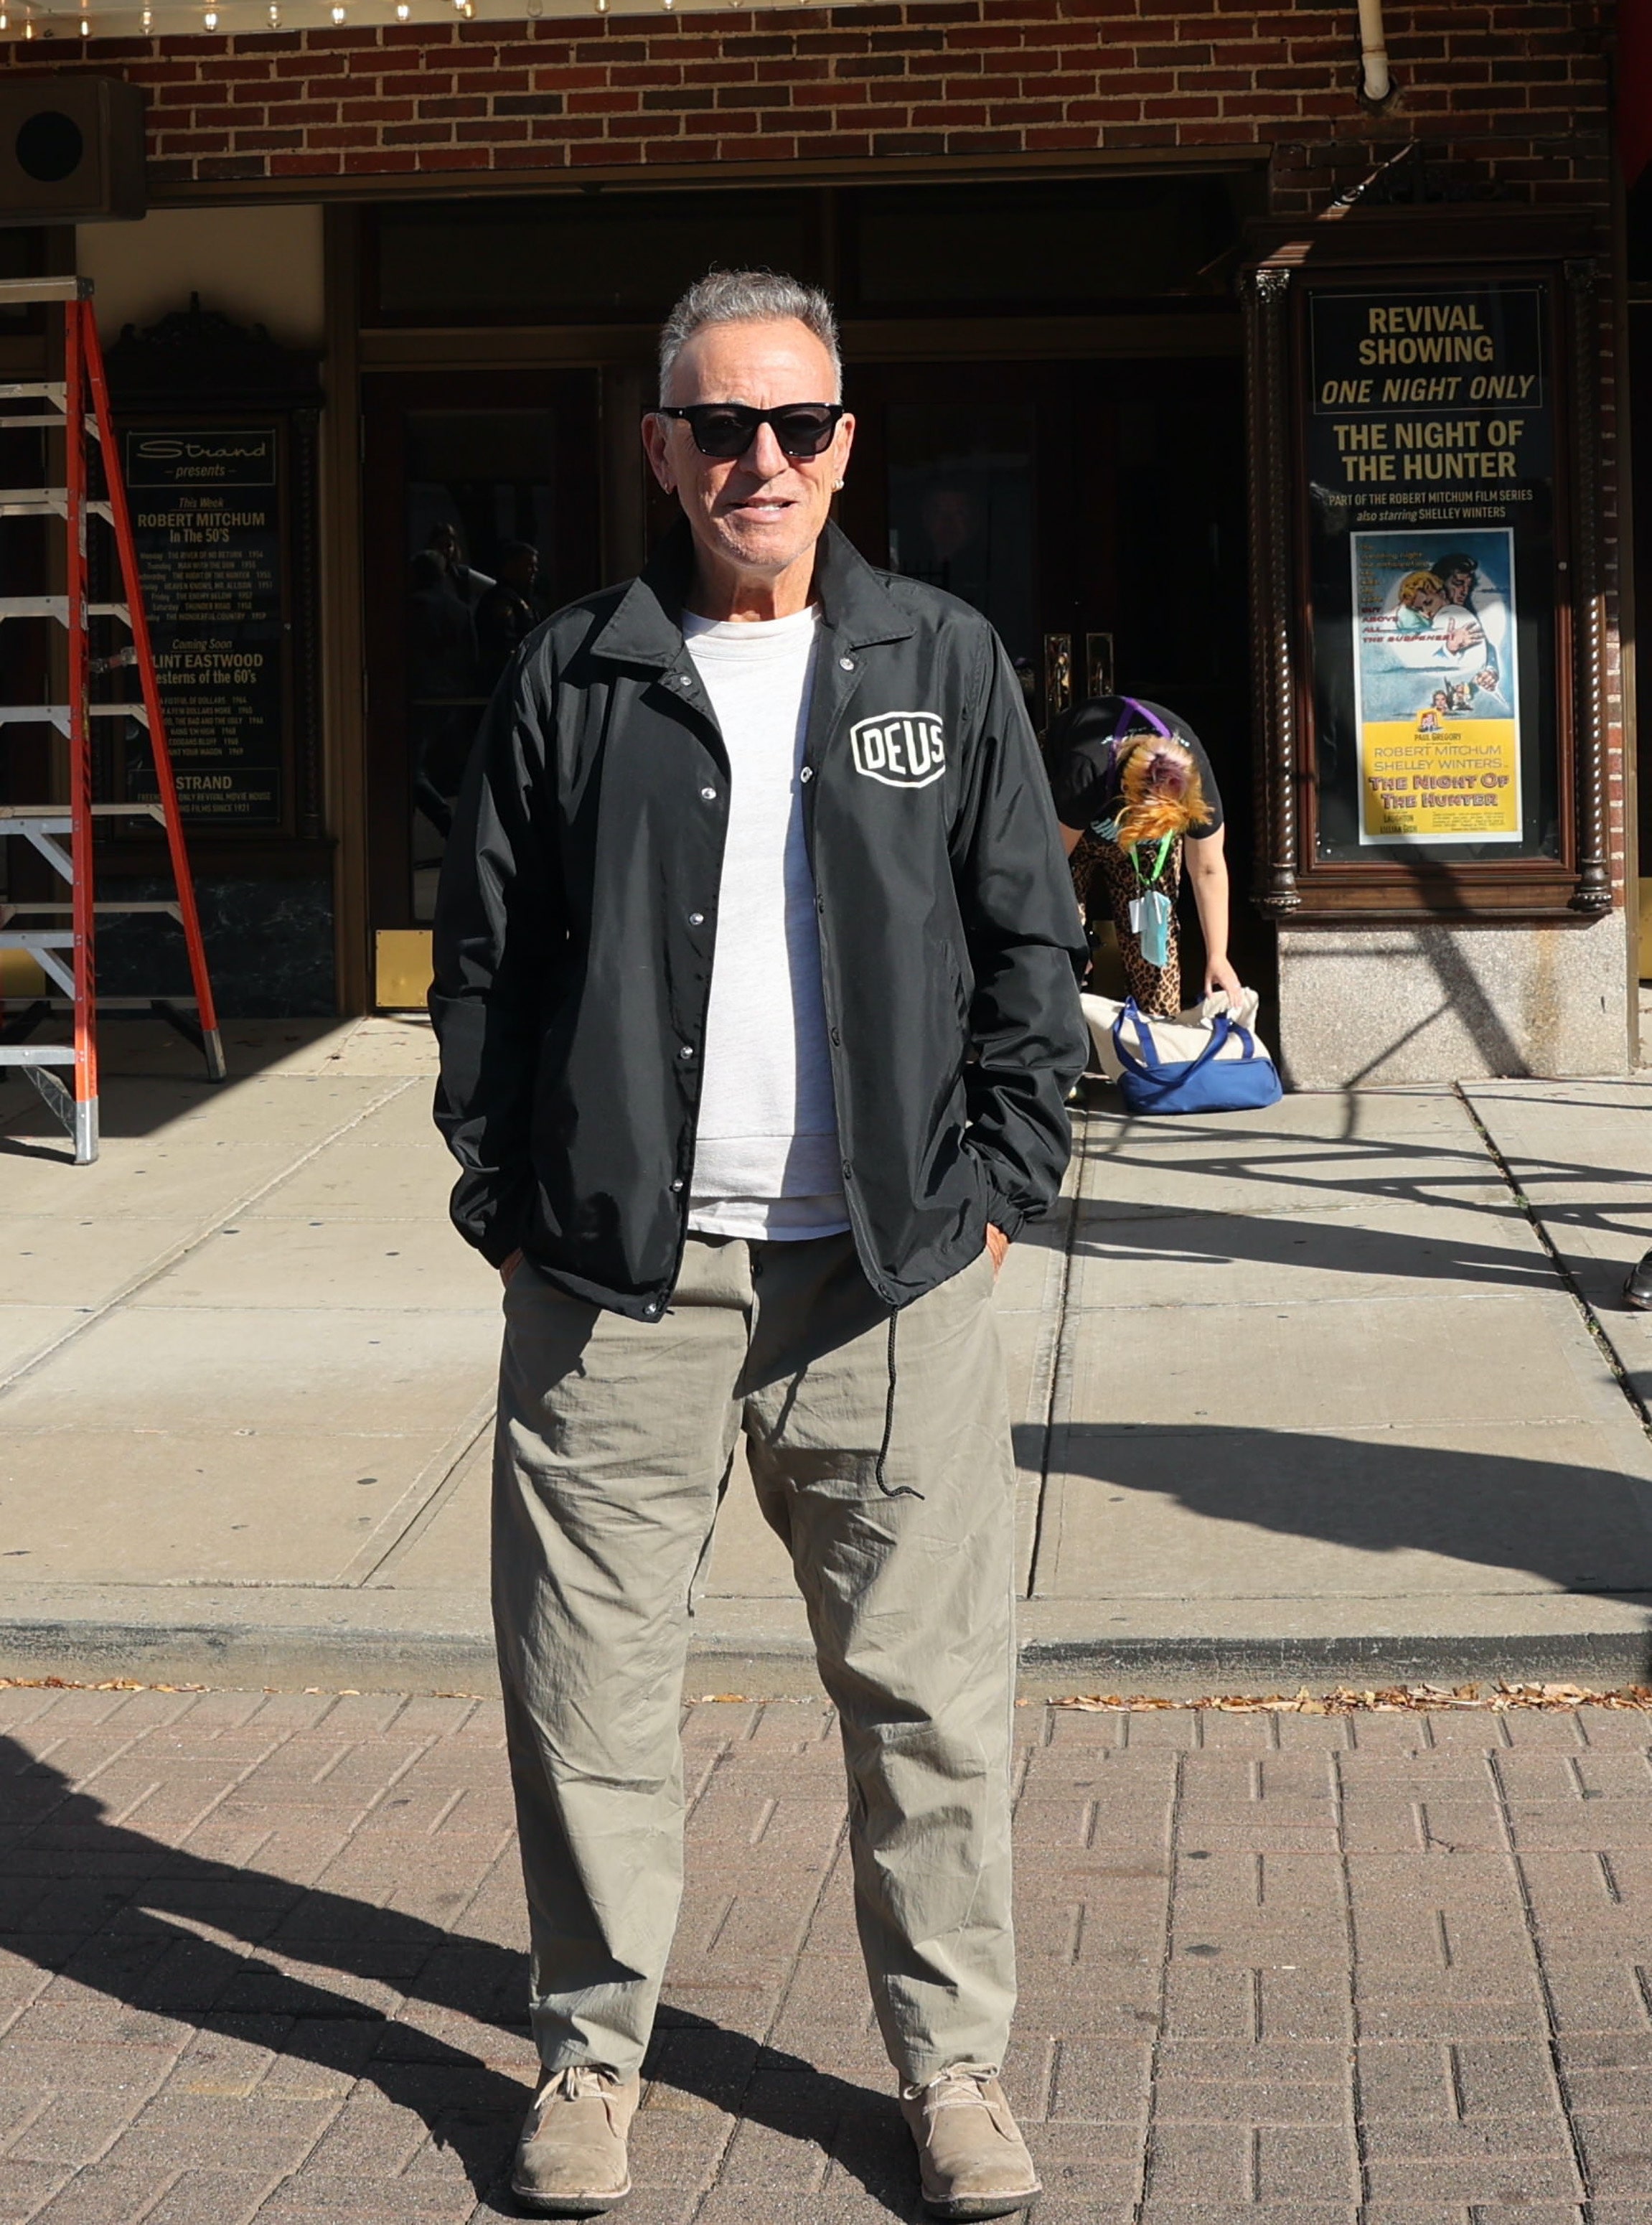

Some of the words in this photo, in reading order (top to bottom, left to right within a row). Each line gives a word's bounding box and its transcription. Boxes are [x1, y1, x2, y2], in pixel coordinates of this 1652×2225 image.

[1369, 305, 1484, 334] REVIVAL
[1359, 336, 1493, 365] SHOWING
[1321, 380, 1374, 404] ONE
[1382, 377, 1461, 403] NIGHT
[1470, 375, 1535, 399] ONLY
[1333, 424, 1388, 451] THE
[1395, 421, 1480, 449] NIGHT
[1488, 420, 1524, 446] OF
[137, 439, 266, 459] Strand
[1341, 455, 1396, 482] THE
[1404, 452, 1516, 480] HUNTER
[179, 497, 197, 508] This
[200, 497, 225, 507] Week
[1328, 495, 1353, 505] PART
[1355, 495, 1367, 505] OF
[1369, 494, 1387, 505] THE
[1389, 492, 1426, 504] ROBERT
[1428, 492, 1473, 503] MITCHUM
[1475, 491, 1497, 502] FILM
[1499, 490, 1533, 501] SERIES
[138, 514, 194, 528] ROBERT
[197, 512, 265, 526] MITCHUM
[1356, 511, 1377, 521] also
[1379, 510, 1417, 523] starring
[1419, 508, 1460, 520] SHELLEY
[1463, 507, 1506, 519] WINTERS
[170, 529, 181, 543] In
[184, 529, 202, 543] The
[205, 528, 230, 543] 50'S
[172, 639, 207, 652] Coming
[209, 638, 233, 650] Soon
[154, 655, 182, 668] LINT
[184, 653, 264, 668] EASTWOOD
[156, 671, 195, 684] esterns
[199, 670, 211, 683] of
[214, 669, 230, 683] the
[234, 668, 258, 683] 60's
[863, 720, 946, 775] DEUS
[1374, 746, 1432, 758] ROBERT
[1435, 745, 1501, 756] MITCHUM
[1374, 760, 1433, 772] SHELLEY
[1438, 758, 1502, 769] WINTERS
[176, 776, 233, 790] STRAND
[1369, 777, 1407, 791] THE
[1413, 774, 1476, 790] NIGHT
[1480, 772, 1510, 788] OF
[1381, 793, 1417, 809] THE
[1421, 792, 1498, 807] HUNTER
